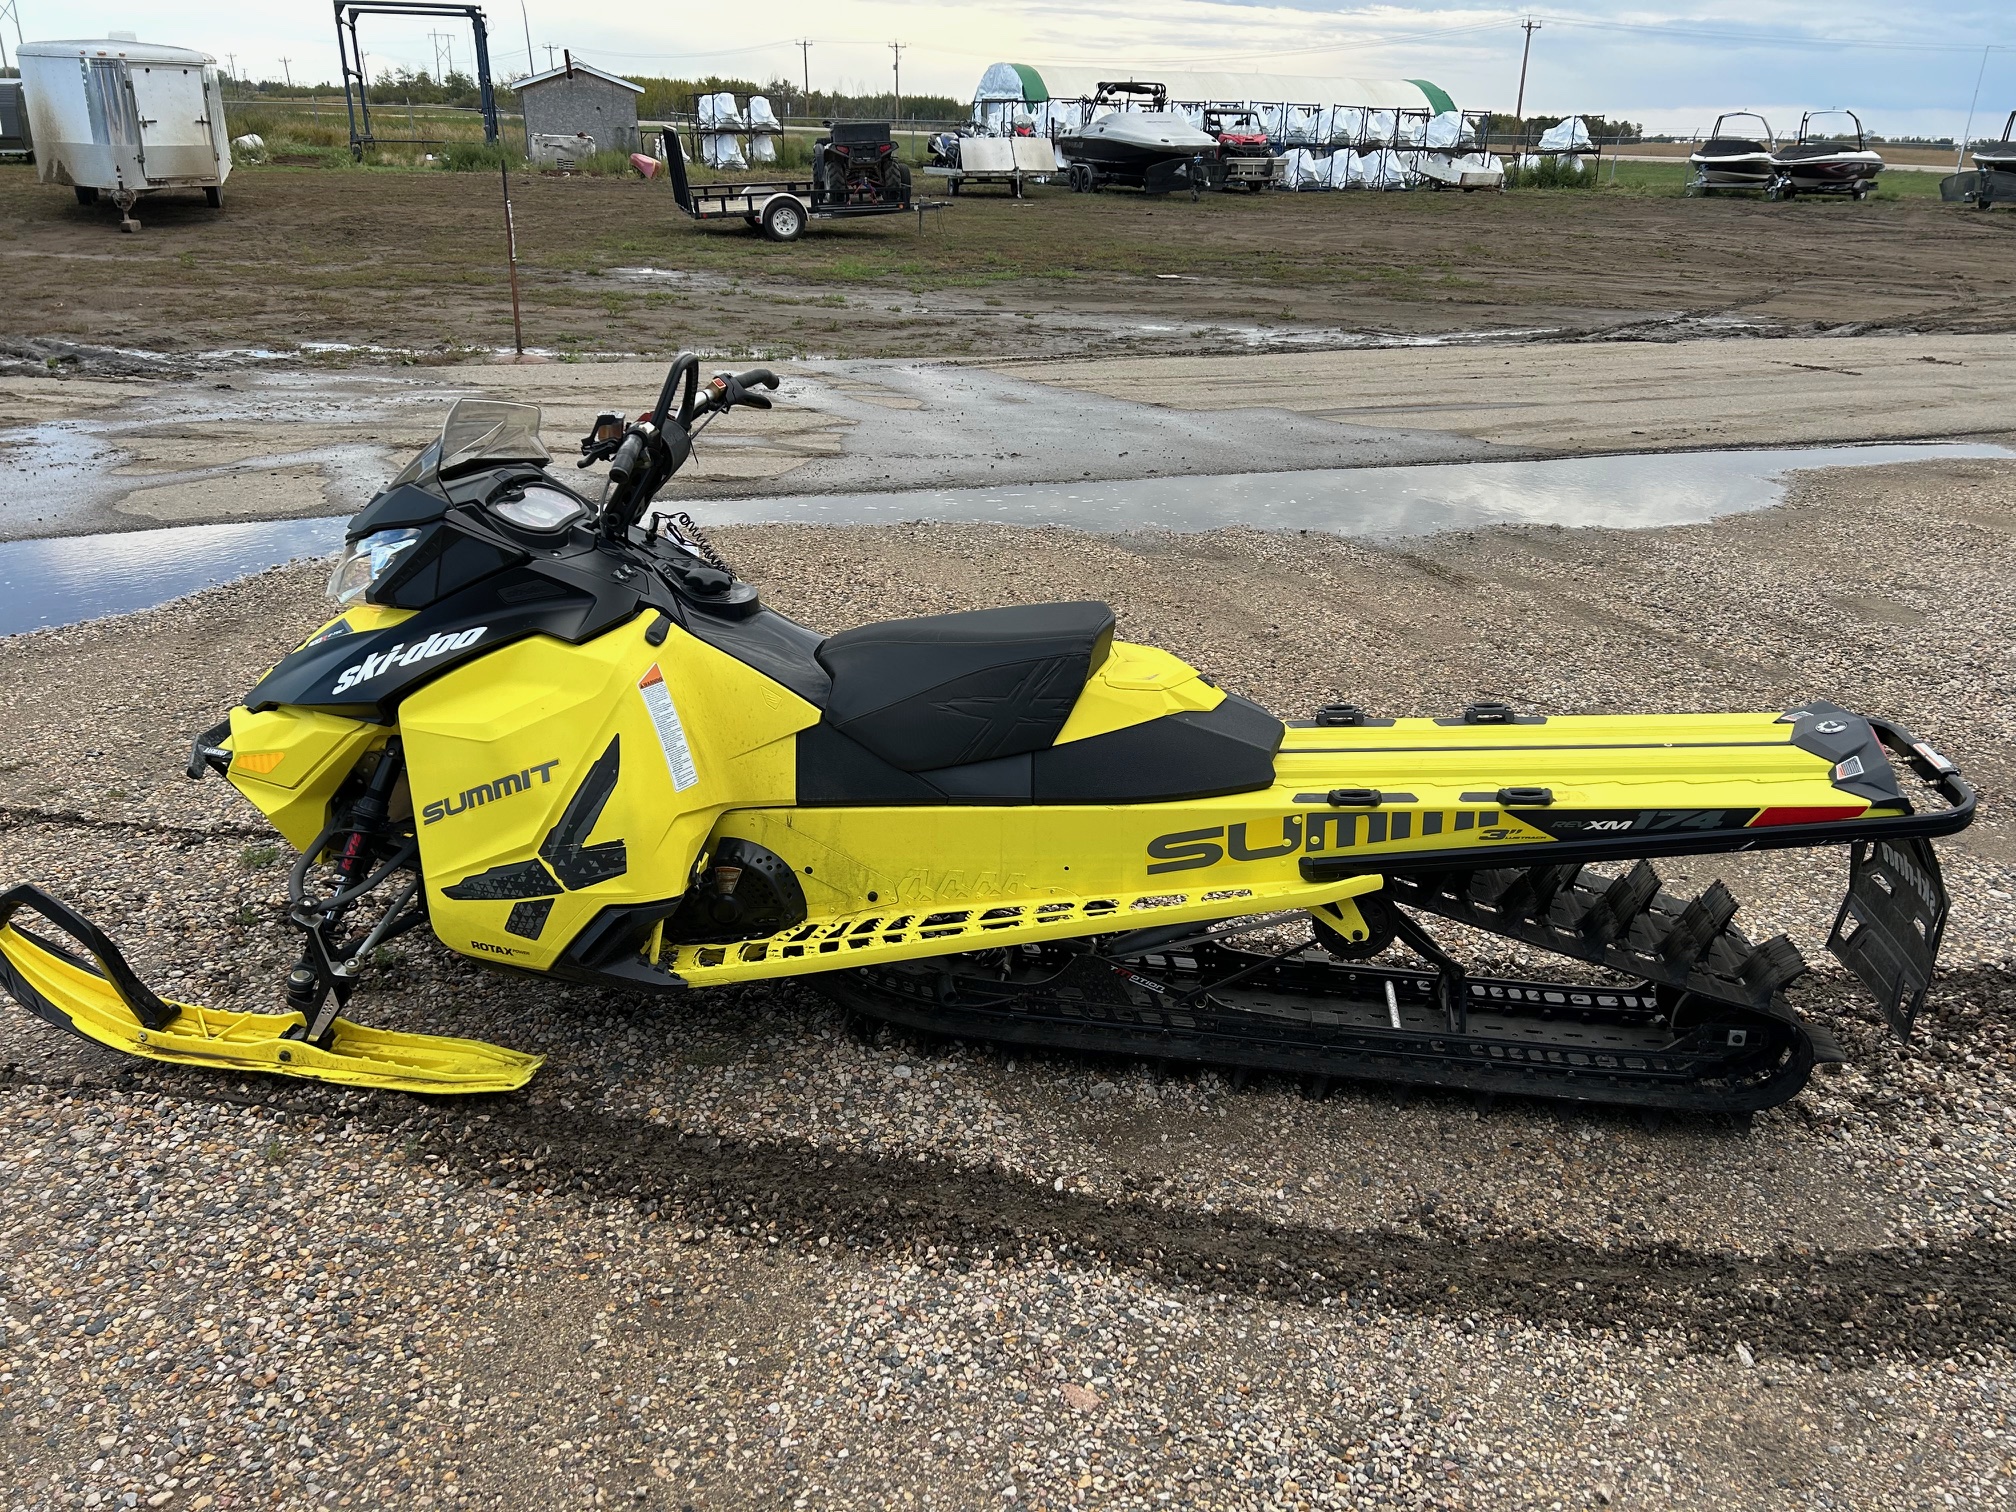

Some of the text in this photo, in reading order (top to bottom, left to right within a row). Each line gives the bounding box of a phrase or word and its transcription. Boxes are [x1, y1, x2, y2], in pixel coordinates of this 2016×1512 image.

[331, 626, 488, 695] ski-doo
[422, 759, 560, 826] SUMMIT
[1631, 810, 1727, 830] 174
[471, 941, 513, 956] ROTAX
